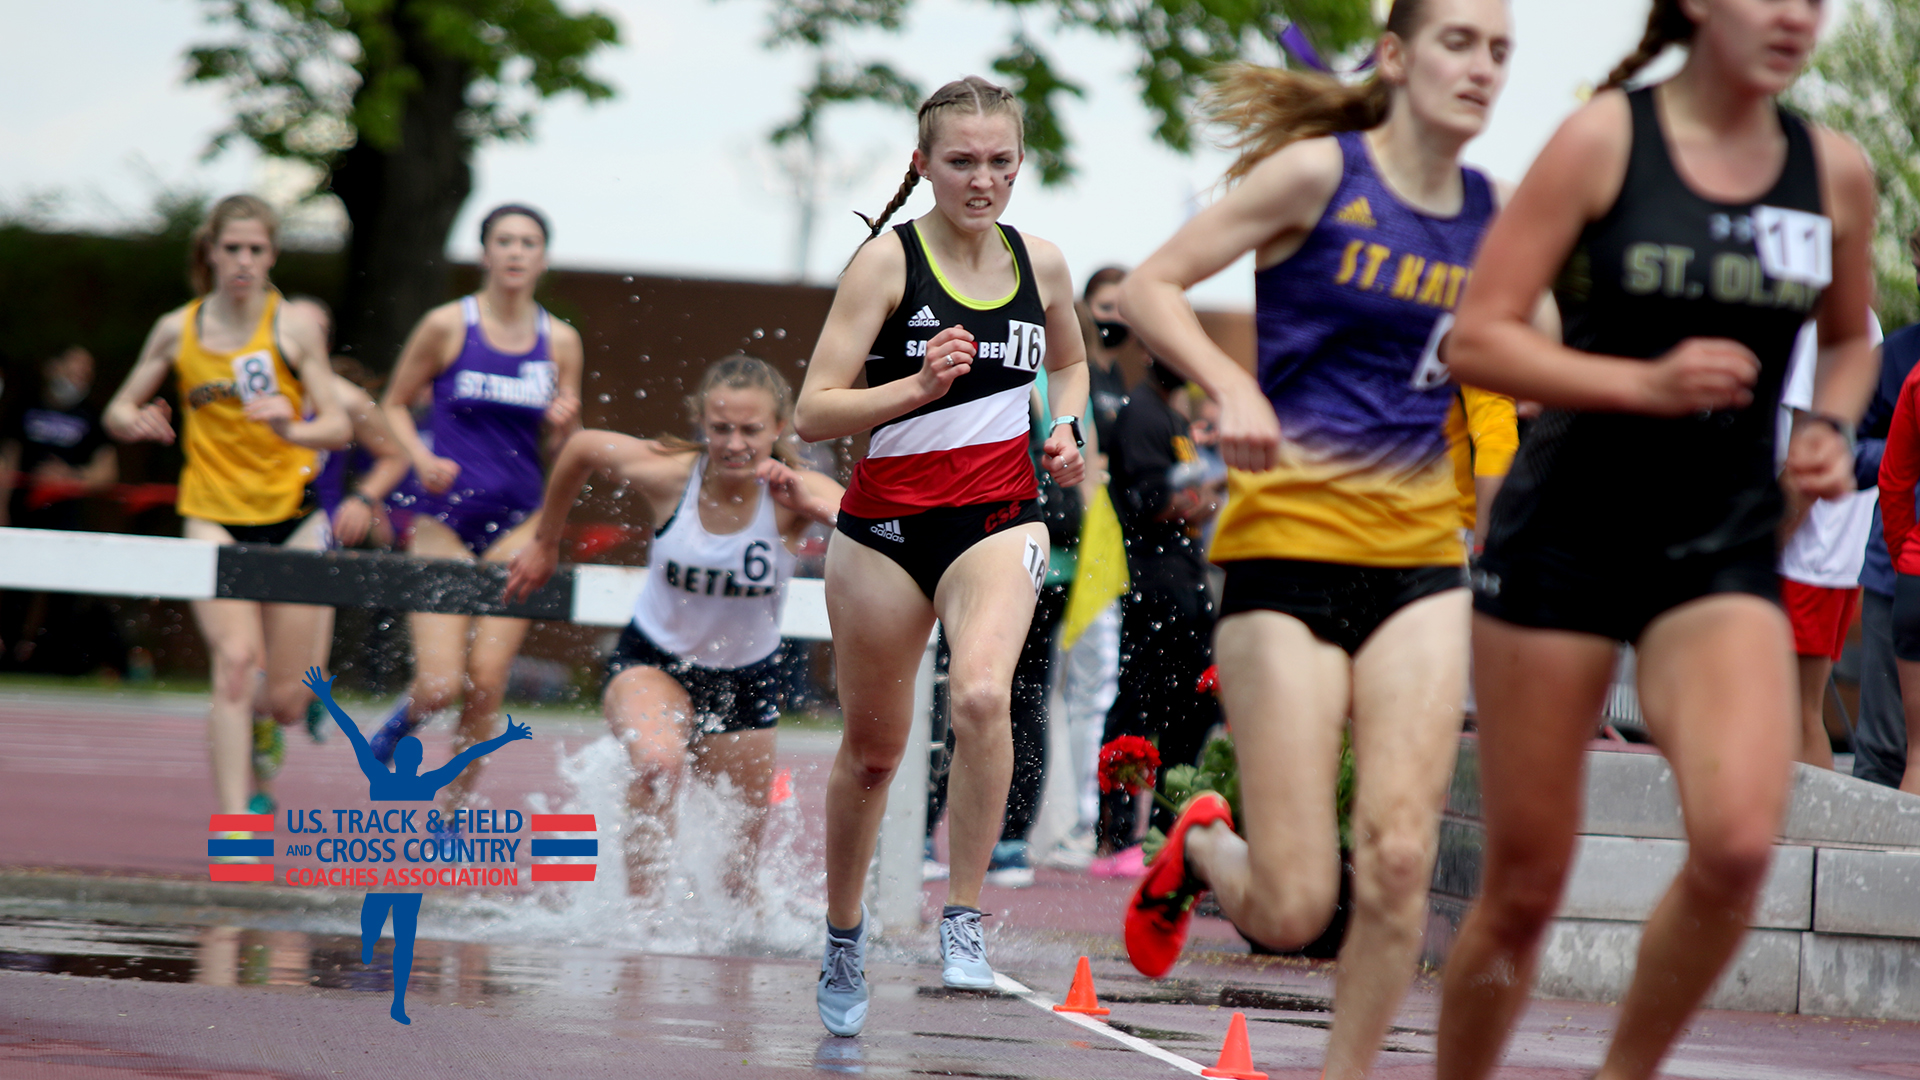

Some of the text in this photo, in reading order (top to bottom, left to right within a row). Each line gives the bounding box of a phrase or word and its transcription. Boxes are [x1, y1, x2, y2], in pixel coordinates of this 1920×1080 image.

[1768, 219, 1821, 276] 11
[1390, 253, 1473, 309] KAT
[1622, 242, 1703, 299] ST.
[907, 318, 941, 327] adidas
[906, 340, 1010, 359] SA BEN
[1013, 324, 1041, 370] 16
[245, 358, 270, 392] 8
[869, 525, 905, 544] adidas
[985, 500, 1022, 533] CSB
[744, 540, 772, 582] 6
[1028, 541, 1046, 597] 16
